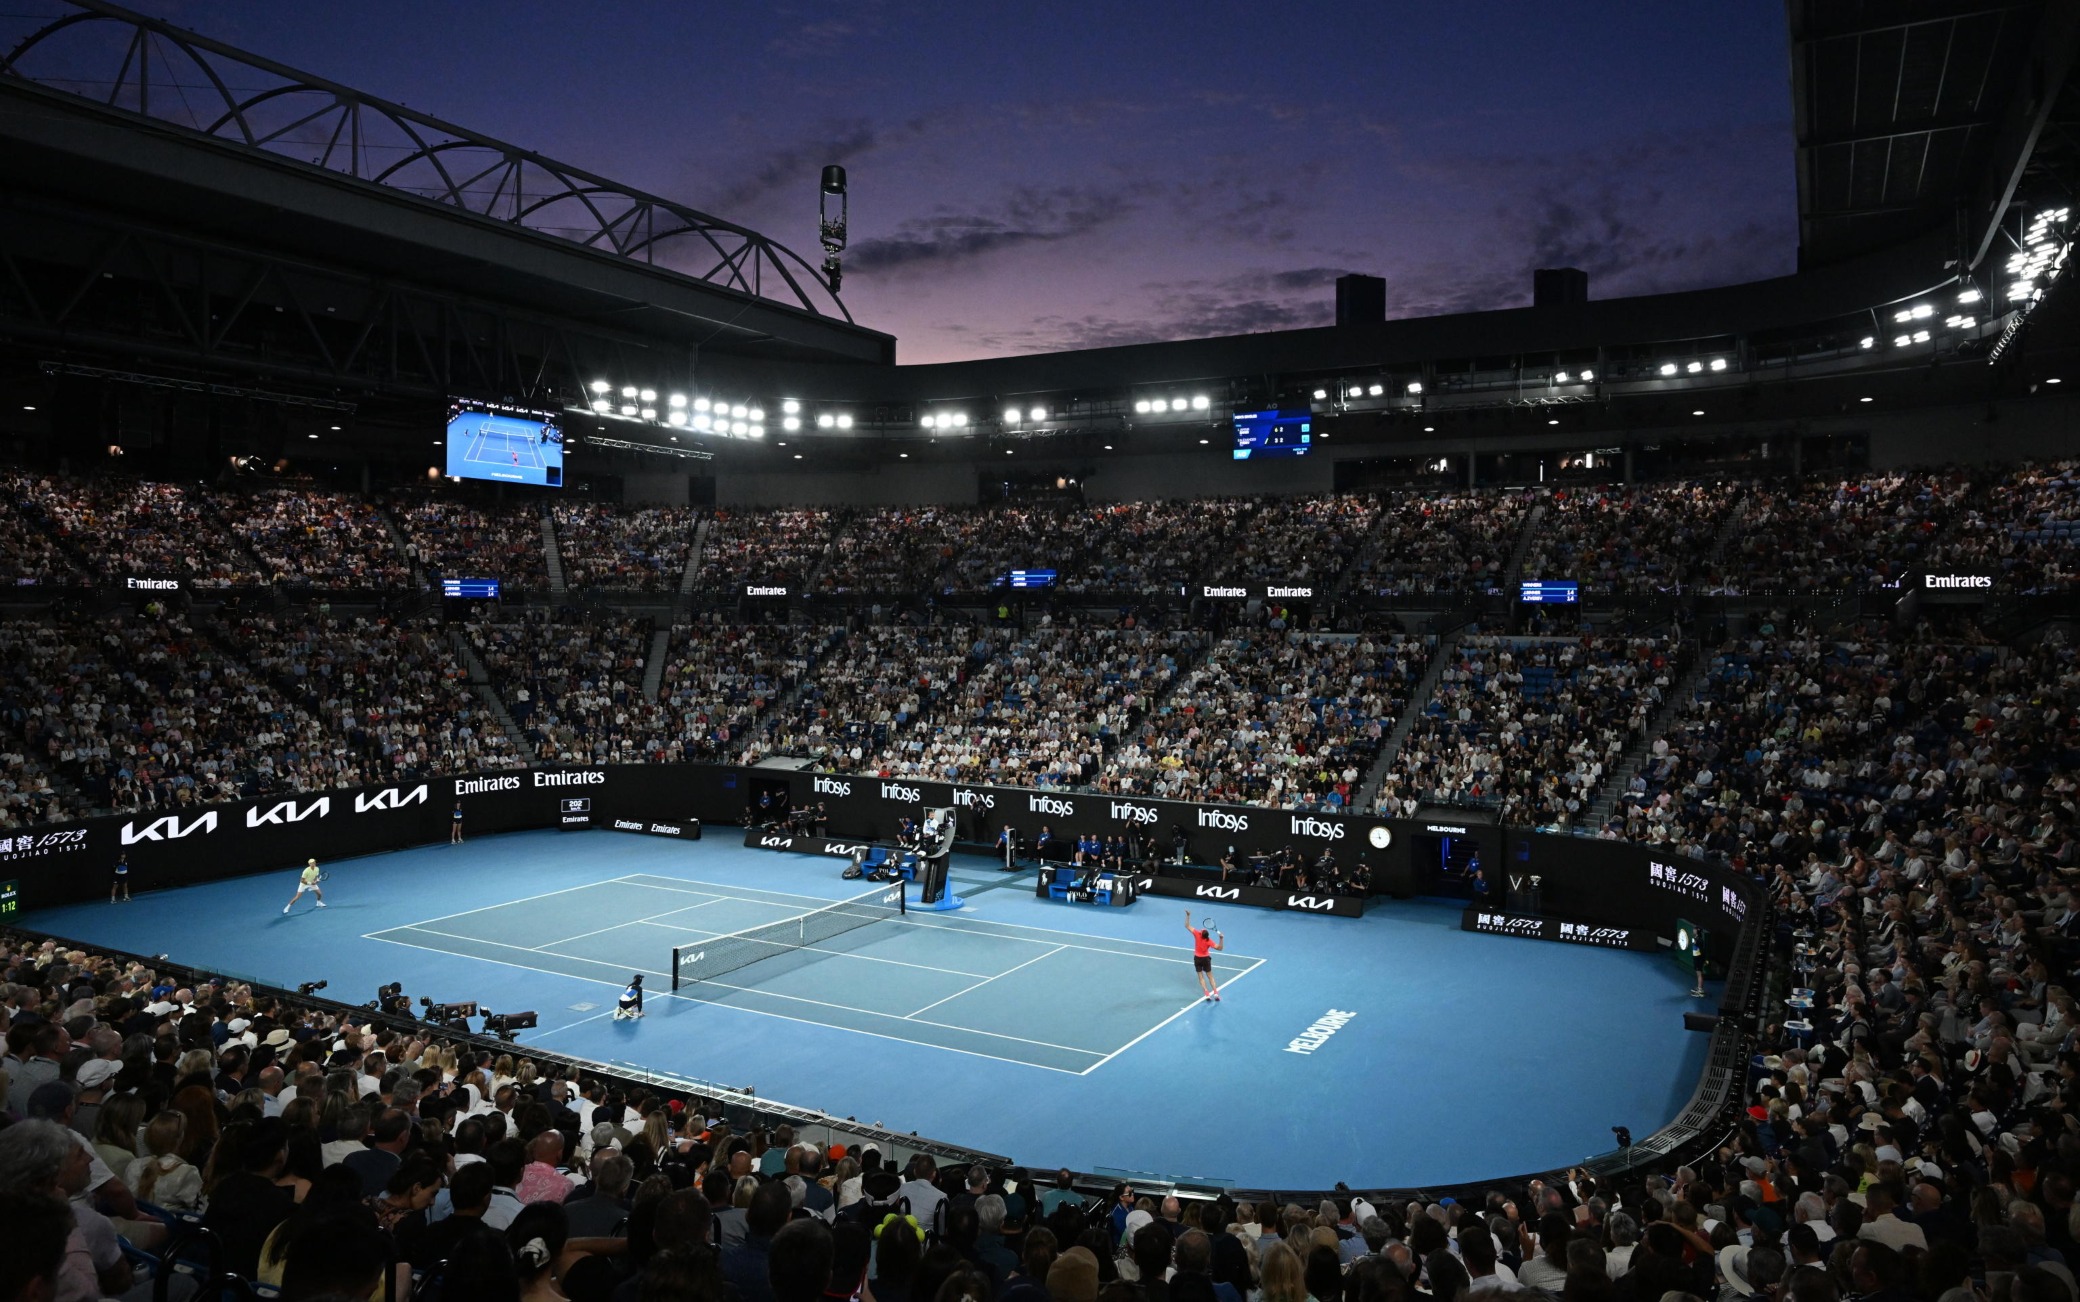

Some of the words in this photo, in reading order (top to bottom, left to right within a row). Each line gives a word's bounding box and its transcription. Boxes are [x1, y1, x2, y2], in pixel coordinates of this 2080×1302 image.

[128, 578, 178, 589] Emirates
[1926, 574, 1991, 587] Emirates
[747, 586, 786, 595] Emirates
[1204, 586, 1246, 596] Emirates
[1267, 586, 1311, 597] Emirates
[534, 770, 604, 786] Emirates
[455, 777, 519, 795] Emirates
[814, 776, 850, 797] Infosys
[881, 782, 920, 803] Infosys
[355, 785, 427, 812] KIA
[953, 788, 995, 808] Infoys
[247, 797, 329, 827] KIA
[1029, 795, 1073, 817] Infosys
[1111, 801, 1158, 825] Infosys
[615, 820, 643, 830] Emirates
[1199, 808, 1248, 832] Infosys
[1291, 815, 1345, 840] Infosys
[121, 811, 217, 845] KIA
[651, 824, 680, 834] Emirates
[761, 837, 792, 847] KIA
[4, 849, 49, 861] UOJIAO
[1196, 885, 1239, 899] KIA
[2, 901, 16, 913] 1:12
[1288, 896, 1334, 910] KIA
[680, 951, 704, 966] KIA
[1281, 1008, 1358, 1055] MELBOURNE
